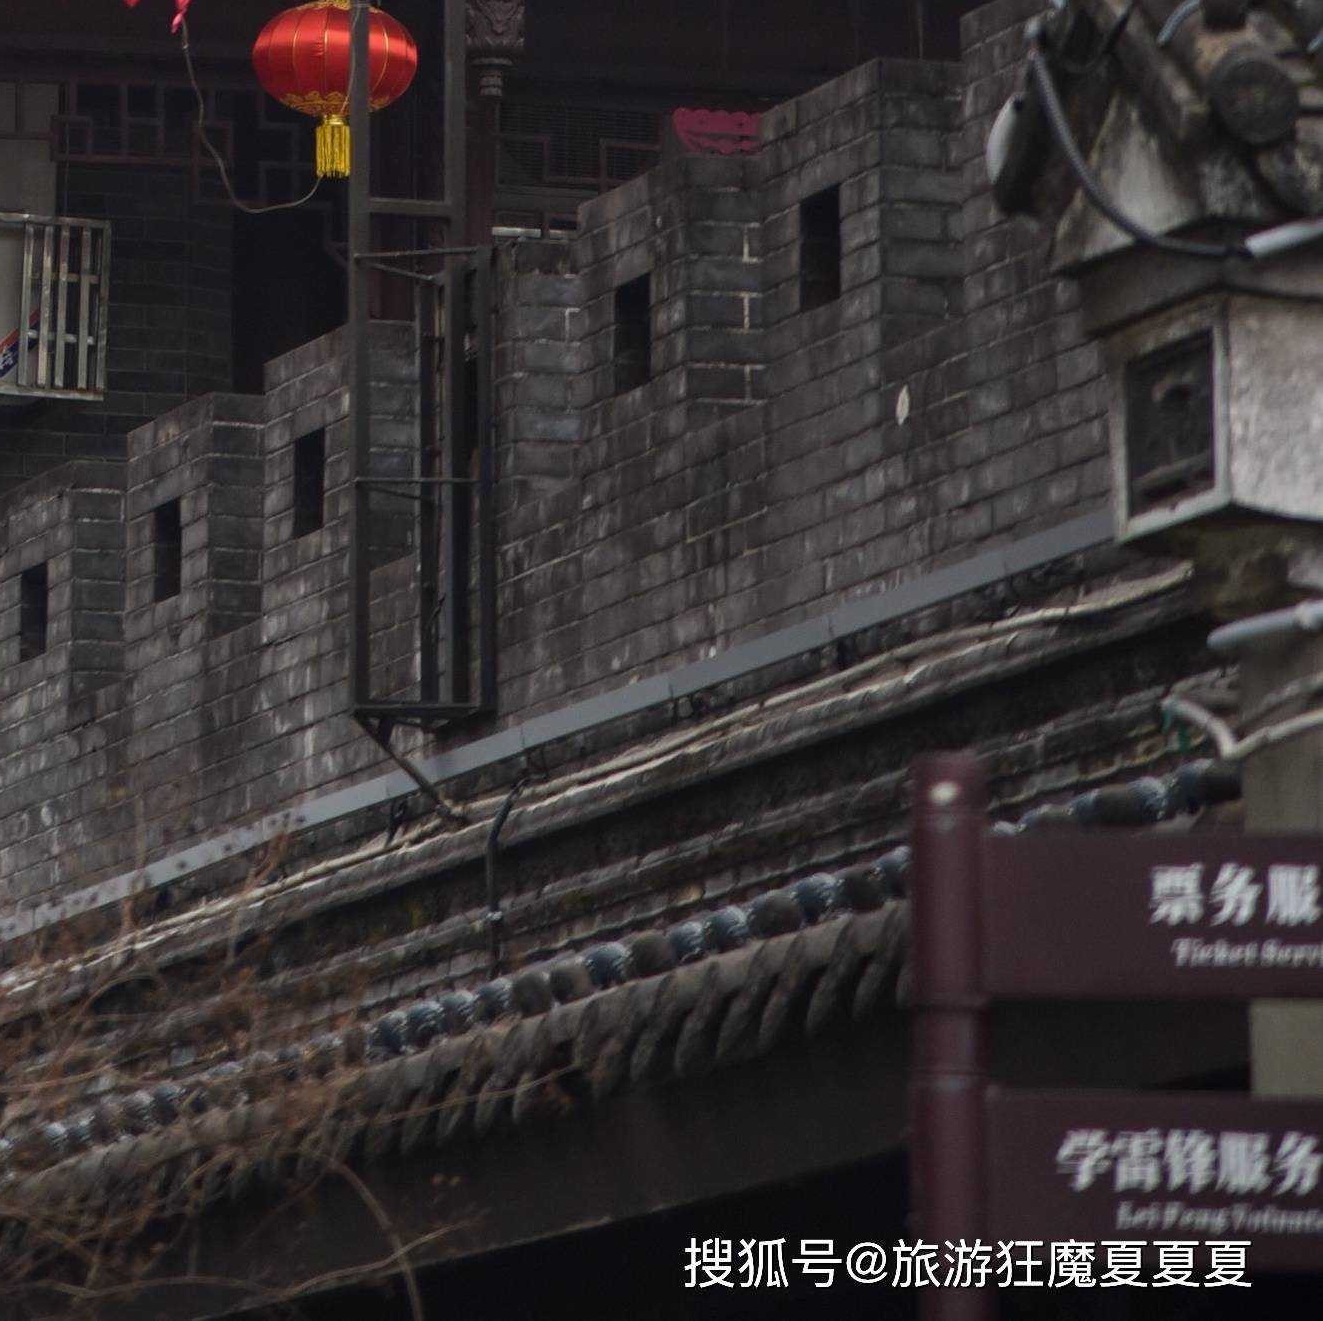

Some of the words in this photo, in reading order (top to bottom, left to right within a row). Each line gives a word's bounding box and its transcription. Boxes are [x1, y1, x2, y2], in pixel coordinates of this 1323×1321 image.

[1056, 1128, 1323, 1196] 学雷锋服务
